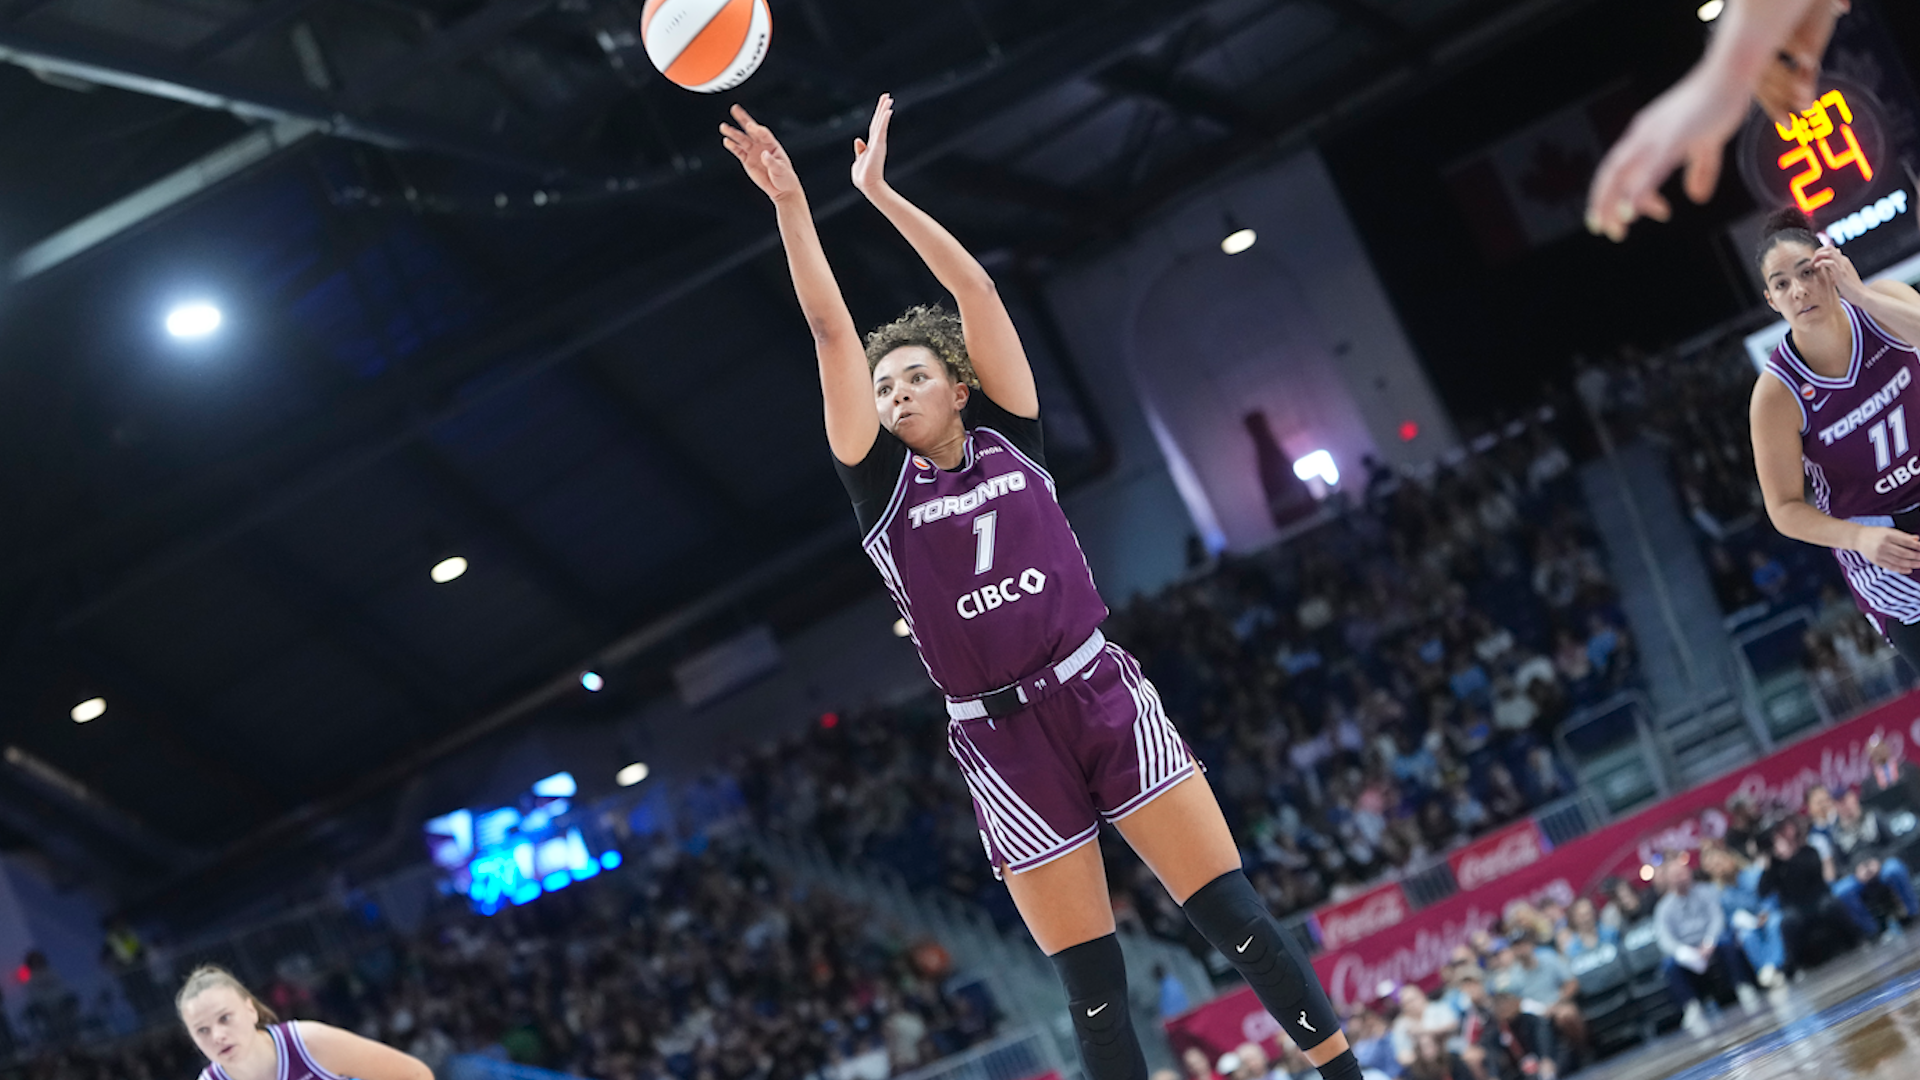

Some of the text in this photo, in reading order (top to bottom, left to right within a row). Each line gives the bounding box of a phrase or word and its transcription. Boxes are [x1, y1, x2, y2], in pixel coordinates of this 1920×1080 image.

[1775, 89, 1854, 146] 4:37
[1778, 124, 1873, 214] 24
[1827, 189, 1908, 245] TISSOT
[1864, 344, 1891, 370] SEPHORA
[1819, 366, 1911, 446] TORONTO
[975, 446, 1003, 461] EPHORA
[1868, 403, 1910, 473] 11
[908, 471, 1027, 529] TORONTO
[1874, 454, 1920, 495] CIBC
[972, 509, 998, 576] 1
[956, 577, 1022, 620] CIBC
